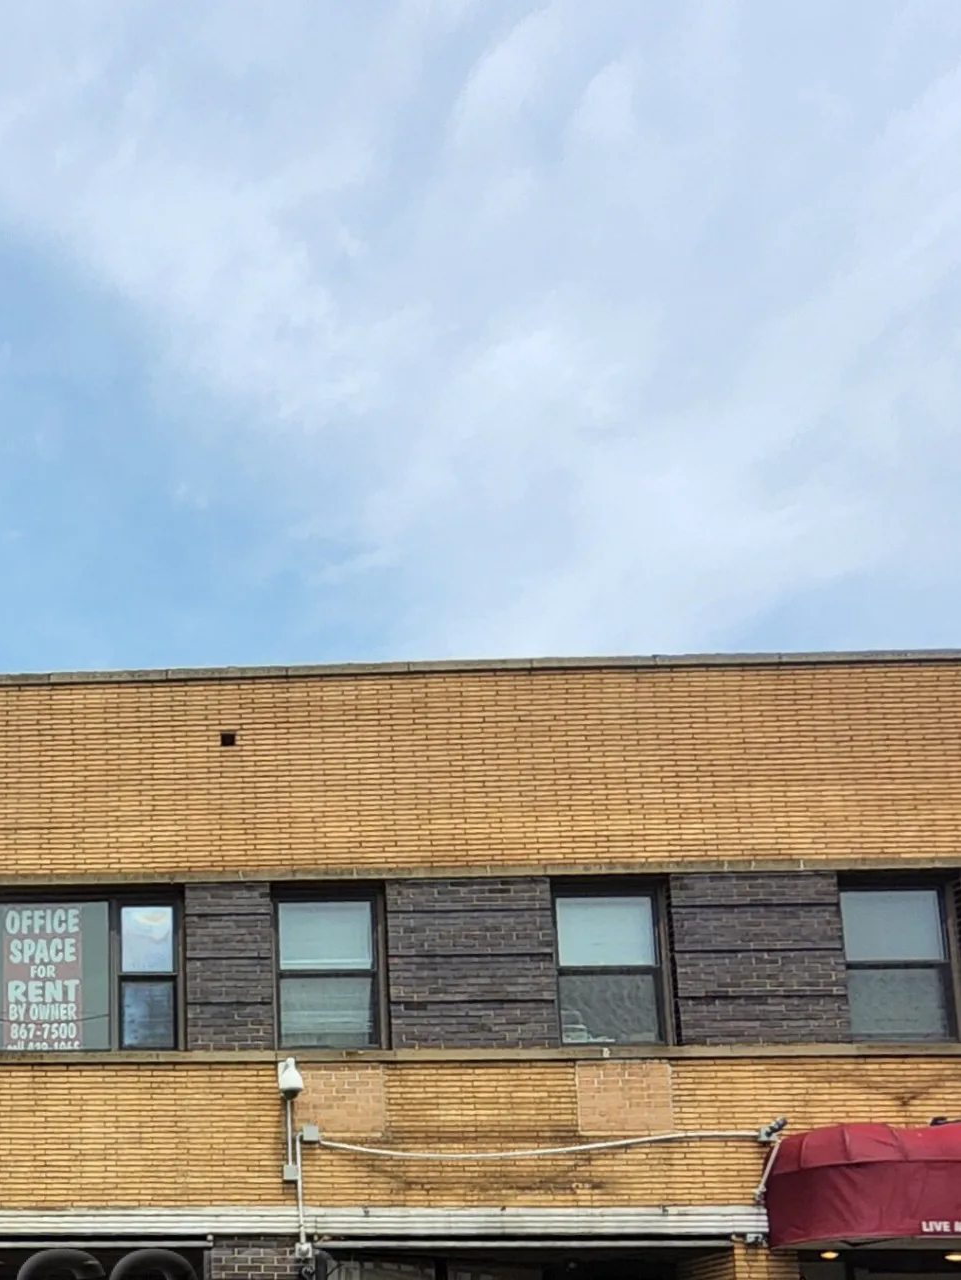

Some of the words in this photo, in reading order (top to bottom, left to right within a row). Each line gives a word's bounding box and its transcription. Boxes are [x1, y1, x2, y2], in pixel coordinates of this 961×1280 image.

[5, 908, 80, 935] OFFICE
[9, 938, 77, 964] SPACE
[30, 965, 56, 979] FOR
[7, 980, 80, 1003] RENT
[8, 1003, 26, 1021] BY
[29, 1003, 77, 1021] OWNER
[10, 1022, 77, 1040] 867-7500
[921, 1221, 950, 1232] LIVE
